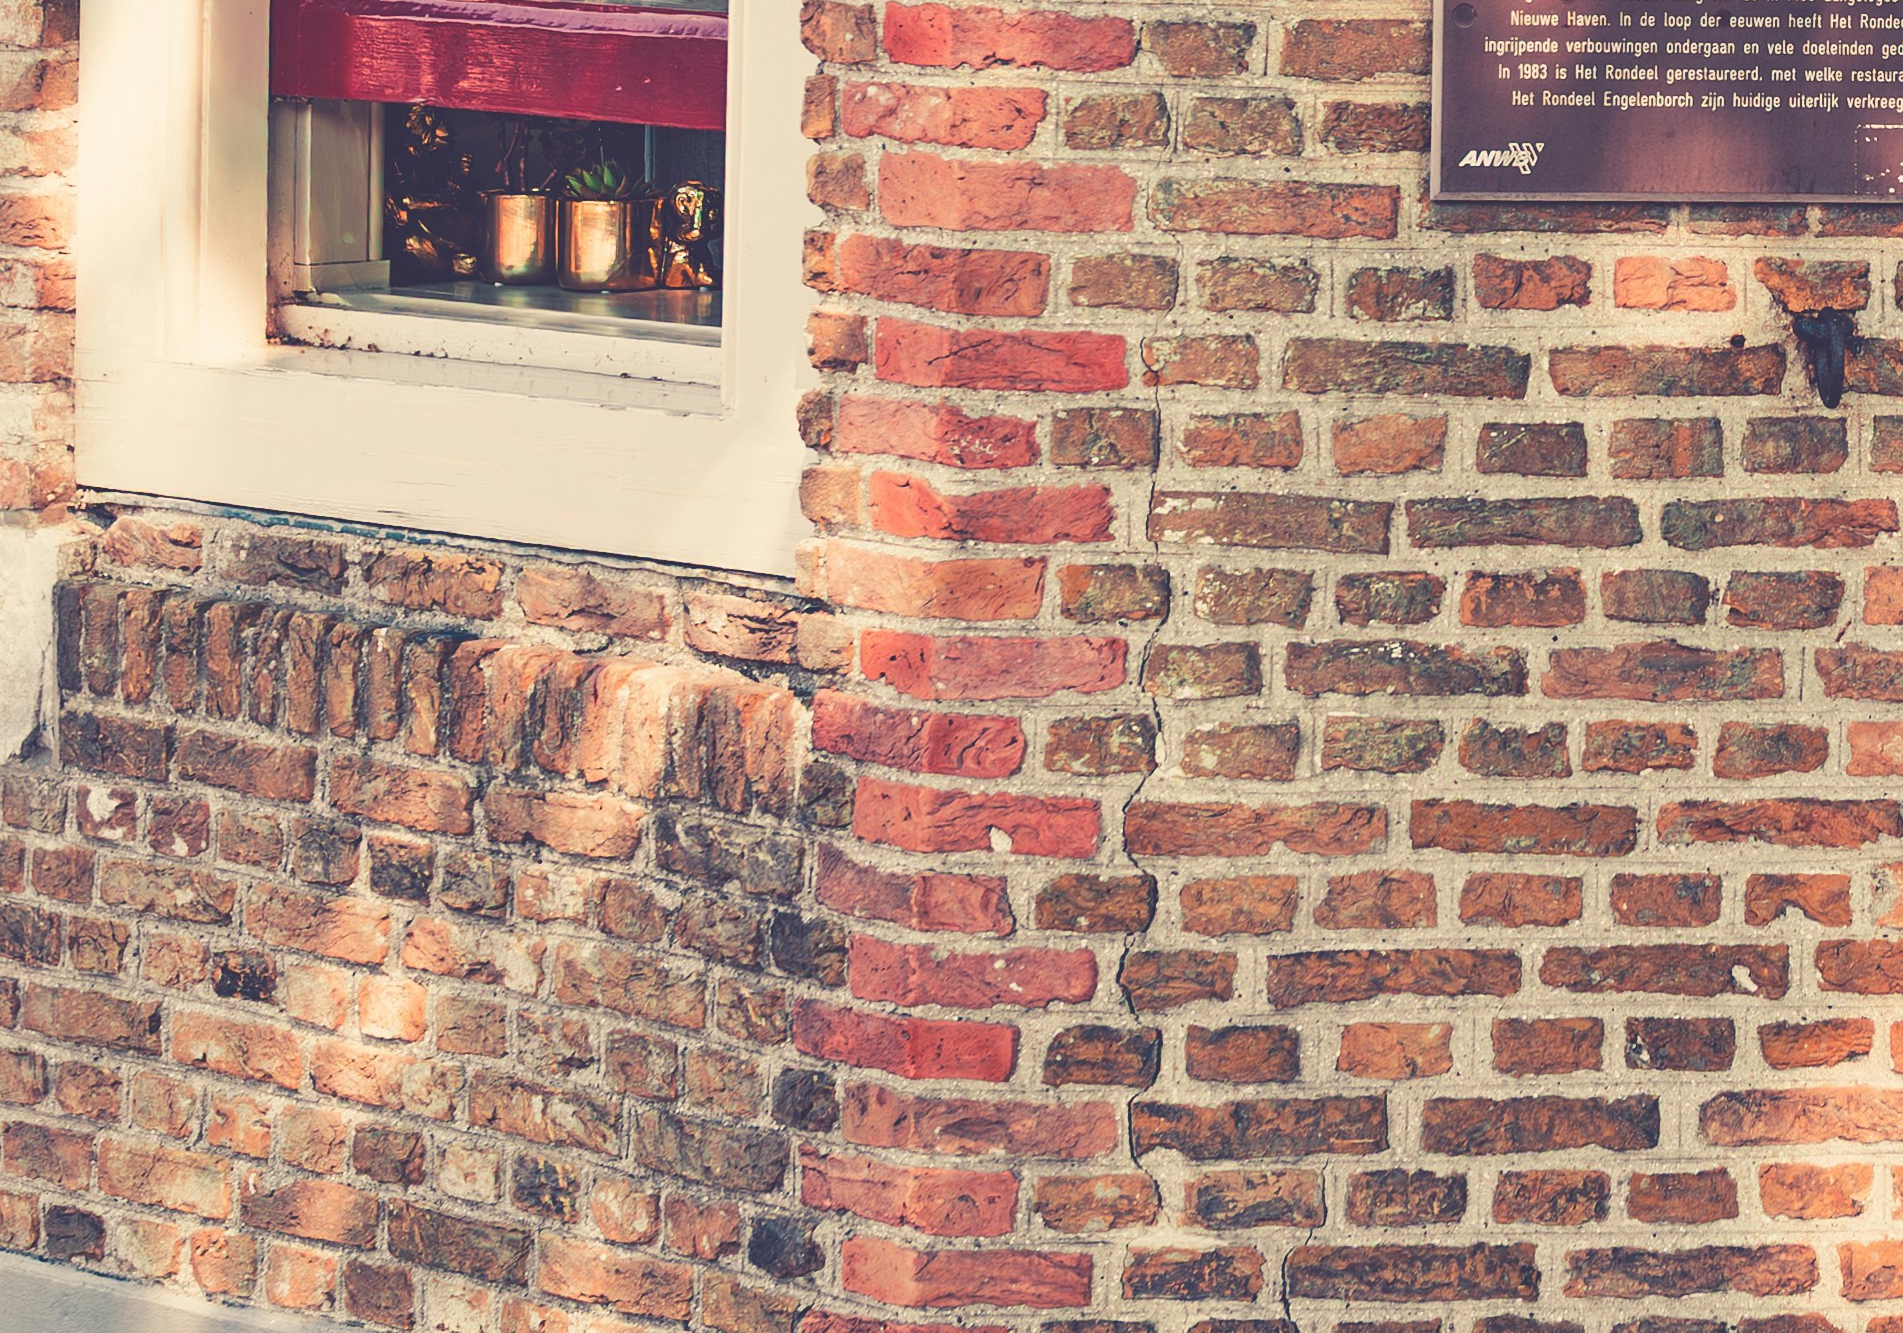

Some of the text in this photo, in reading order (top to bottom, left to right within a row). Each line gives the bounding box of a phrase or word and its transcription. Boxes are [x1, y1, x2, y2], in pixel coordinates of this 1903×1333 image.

[1510, 9, 1560, 27] Nieuwe
[1567, 10, 1611, 27] Haven.
[1619, 11, 1632, 27] In
[1639, 11, 1656, 27] de
[1663, 11, 1692, 32] loop
[1699, 11, 1722, 28] der
[1729, 15, 1781, 29] eeuwen
[1788, 12, 1823, 29] heeft
[1829, 13, 1853, 30] Het
[1484, 36, 1559, 57] ingrijpende
[1565, 37, 1658, 58] verbouwingen
[1665, 38, 1736, 58] ondergaan
[1743, 42, 1760, 55] en
[1766, 39, 1795, 55] vele
[1802, 39, 1874, 56] doeleinden
[1498, 63, 1511, 80] In
[1517, 63, 1548, 80] 1983
[1555, 63, 1568, 80] is
[1575, 63, 1598, 80] Het
[1605, 64, 1659, 81] Rondeel
[1771, 67, 1797, 82] met
[1804, 66, 1843, 82] welke
[1511, 90, 1535, 106] Het
[1542, 89, 1596, 107] Rondeel
[1603, 90, 1694, 111] Engelenborch
[1700, 91, 1725, 112] zijn
[1732, 91, 1781, 112] huidige
[1788, 92, 1839, 113] uiterlijk
